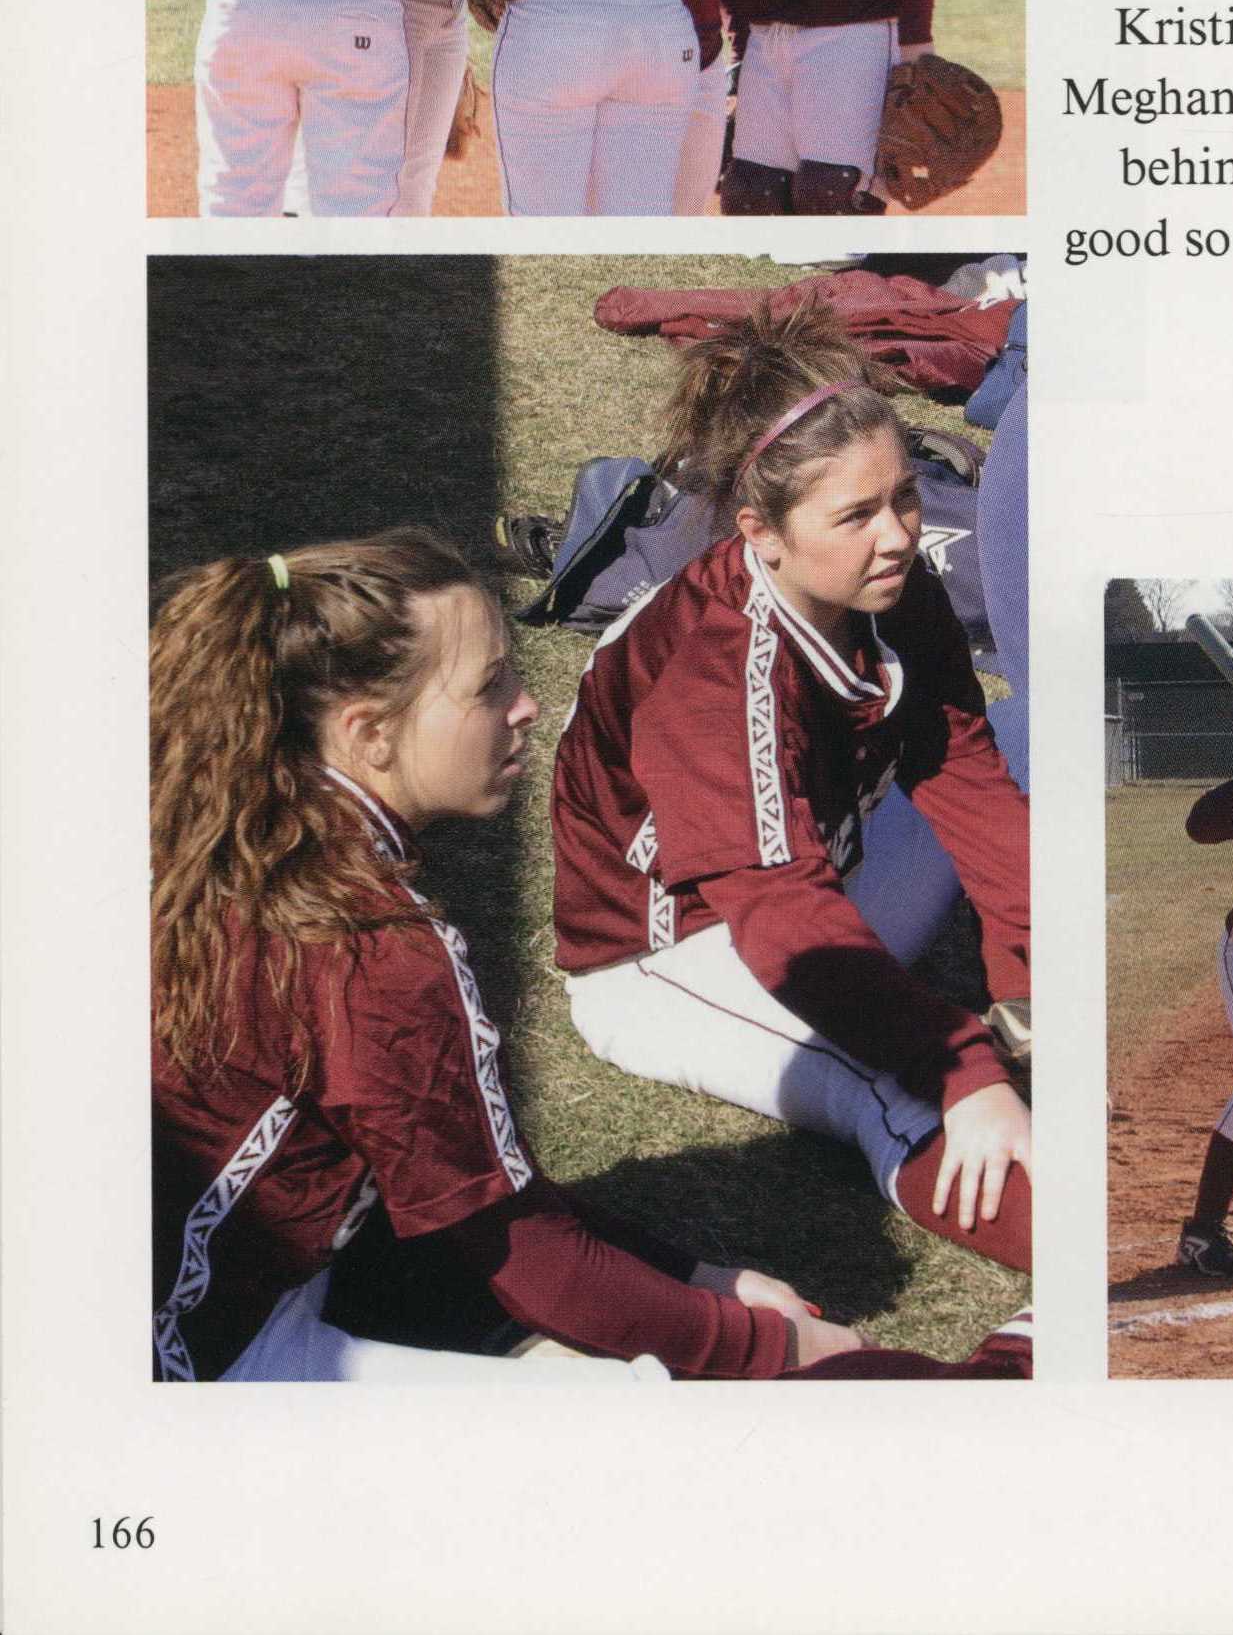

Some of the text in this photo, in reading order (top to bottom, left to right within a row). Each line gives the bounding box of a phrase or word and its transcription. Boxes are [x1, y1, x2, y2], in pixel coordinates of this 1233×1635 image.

[1064, 218, 1171, 266] good
[1185, 229, 1230, 257] so
[92, 1515, 155, 1549] 166
